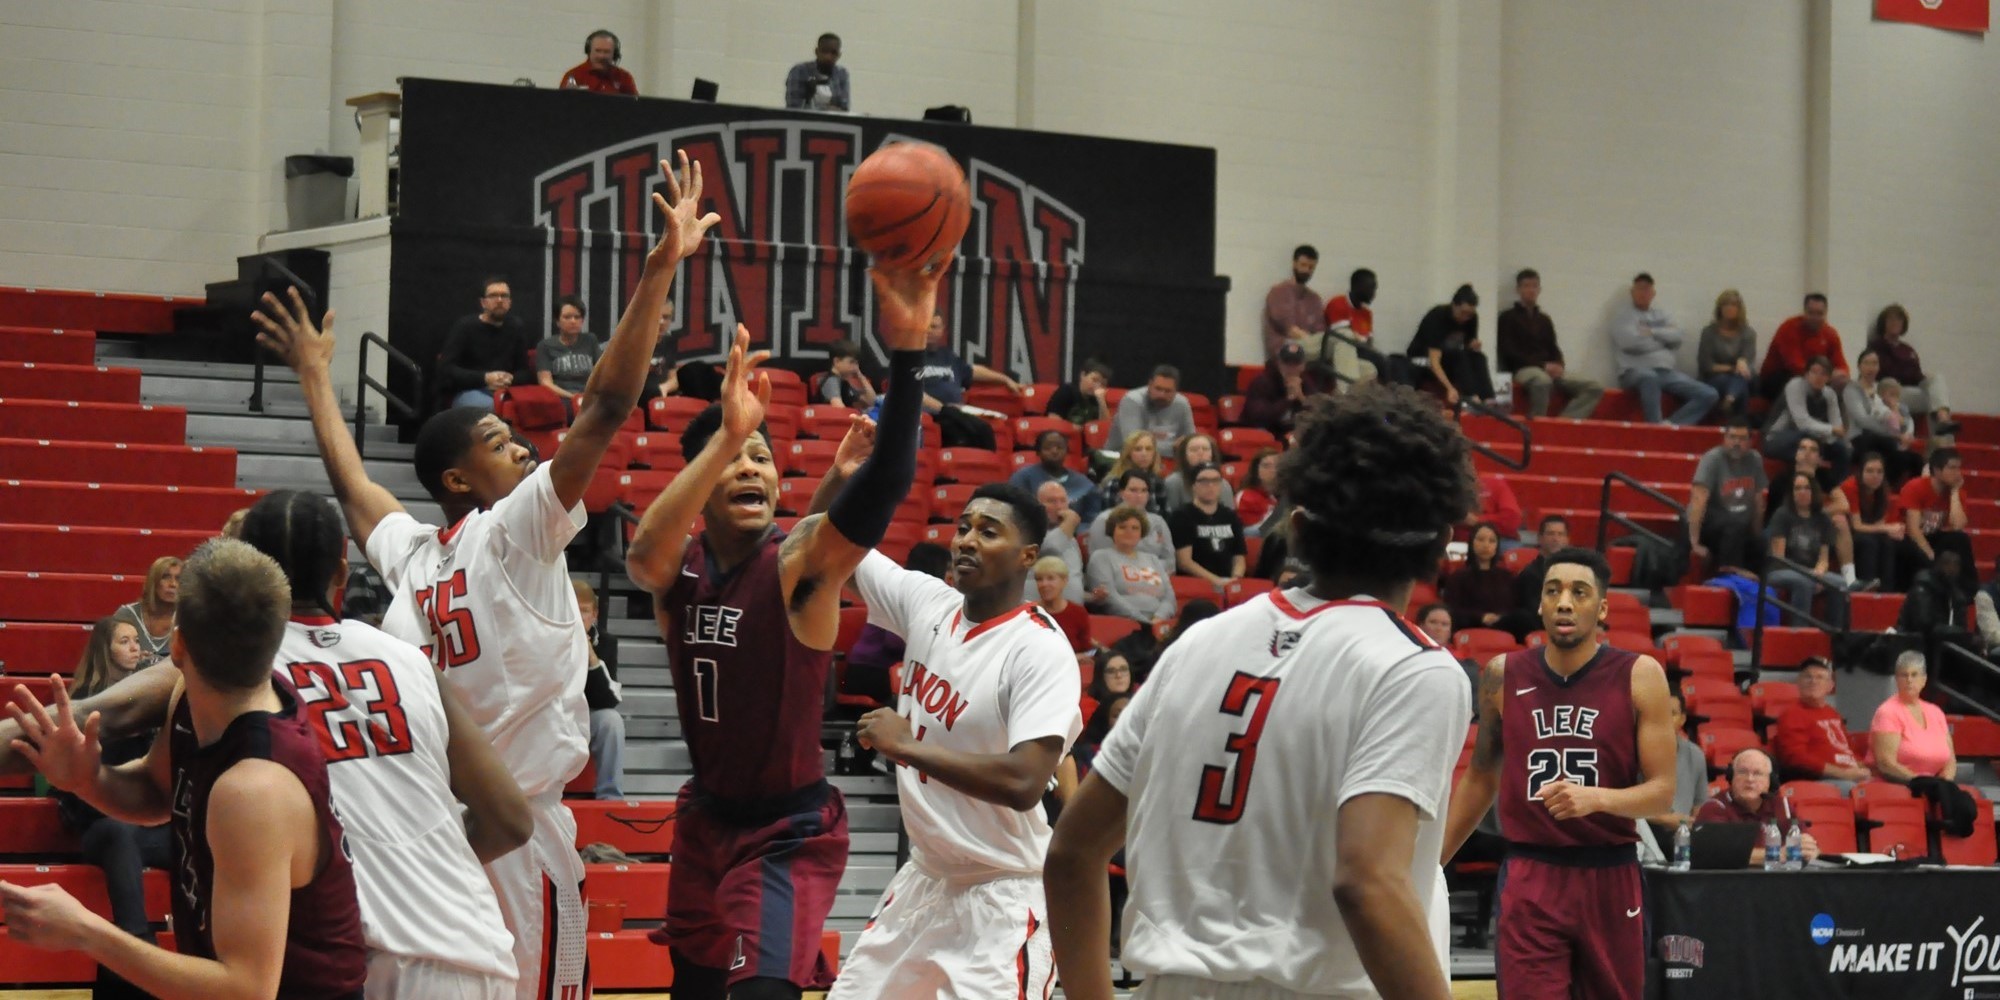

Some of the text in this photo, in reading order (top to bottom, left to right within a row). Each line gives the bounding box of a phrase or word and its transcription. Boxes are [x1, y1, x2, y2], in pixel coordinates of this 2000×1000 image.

[416, 568, 481, 672] 35
[683, 604, 743, 647] LEE
[287, 658, 414, 764] 23
[694, 657, 718, 722] 1
[1192, 670, 1281, 825] 3
[1532, 705, 1599, 739] LEE
[1527, 748, 1598, 801] 25
[1829, 943, 1912, 973] MAKE
[1916, 942, 1945, 971] IT
